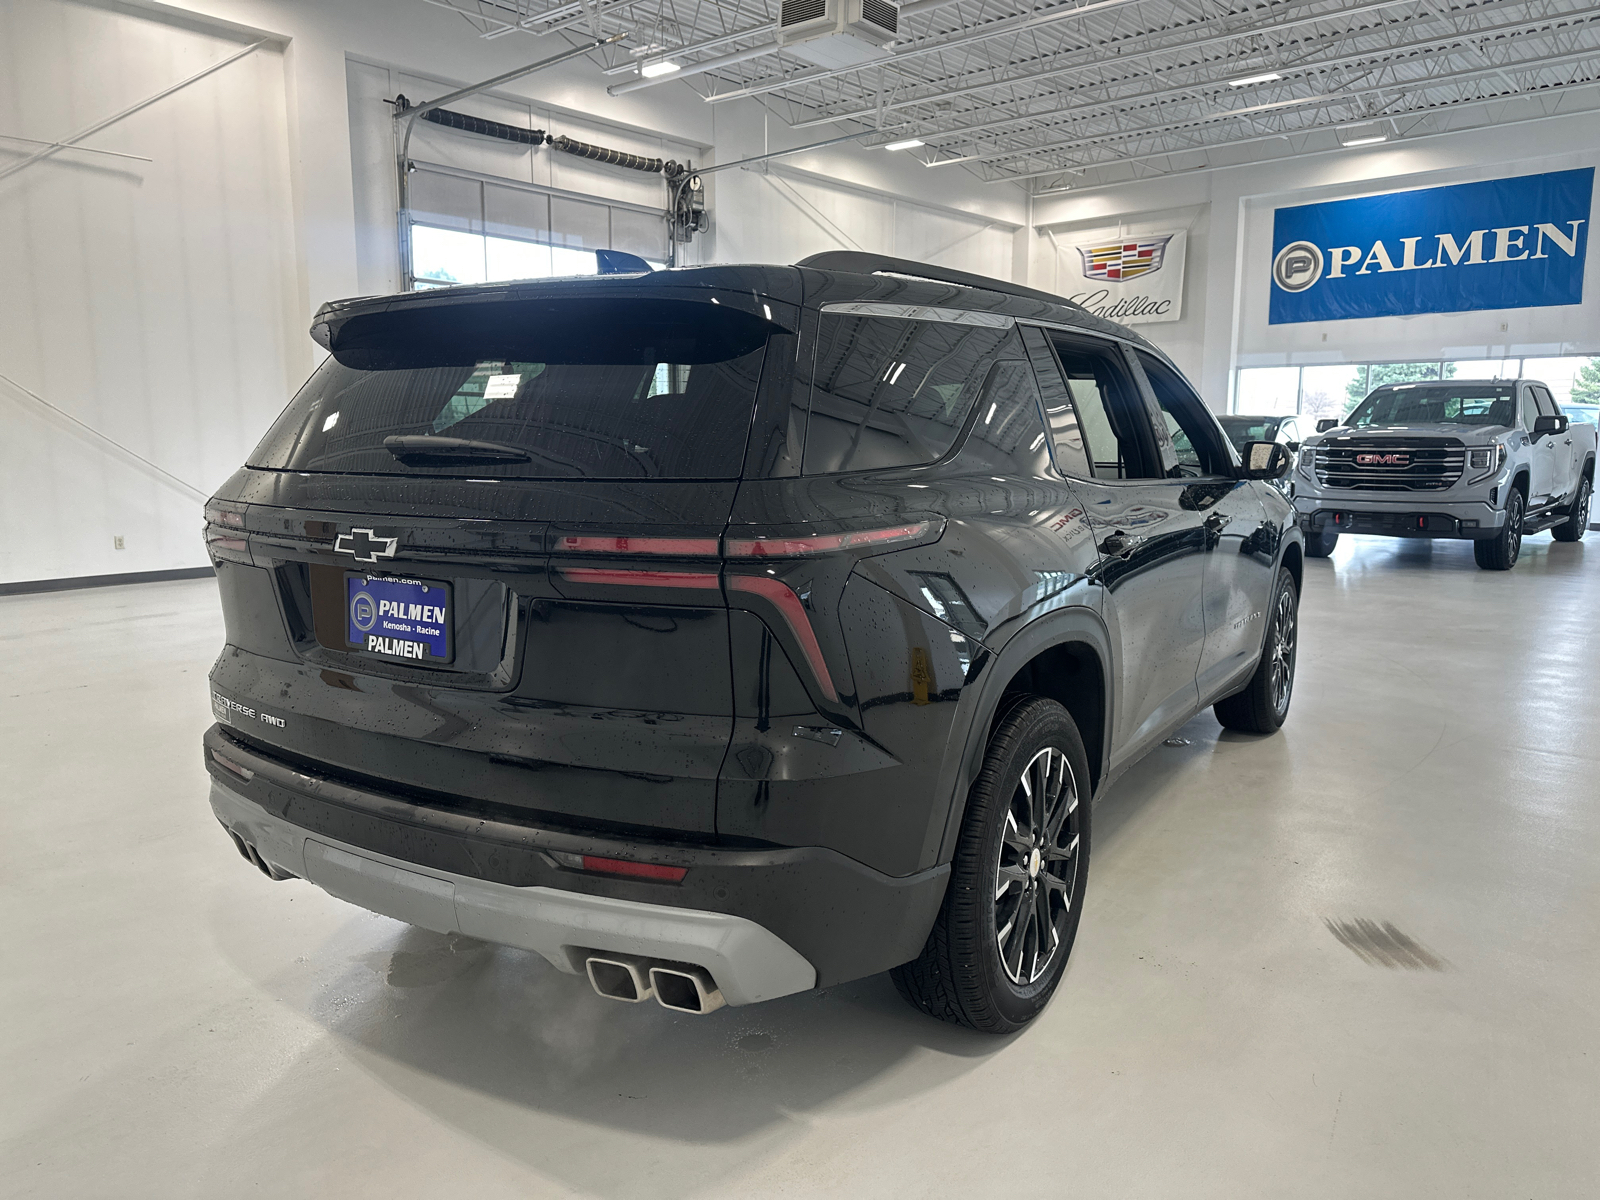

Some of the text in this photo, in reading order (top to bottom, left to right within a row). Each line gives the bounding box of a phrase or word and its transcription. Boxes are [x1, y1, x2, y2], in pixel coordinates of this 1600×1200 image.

[1325, 219, 1586, 279] PALMEN
[1069, 289, 1171, 319] Cadillac
[1356, 454, 1410, 464] GMC
[379, 599, 446, 624] PALMEN
[383, 620, 411, 632] Kenosha
[416, 625, 440, 637] Racine
[367, 635, 424, 660] PALMEN
[260, 713, 286, 729] AWD
